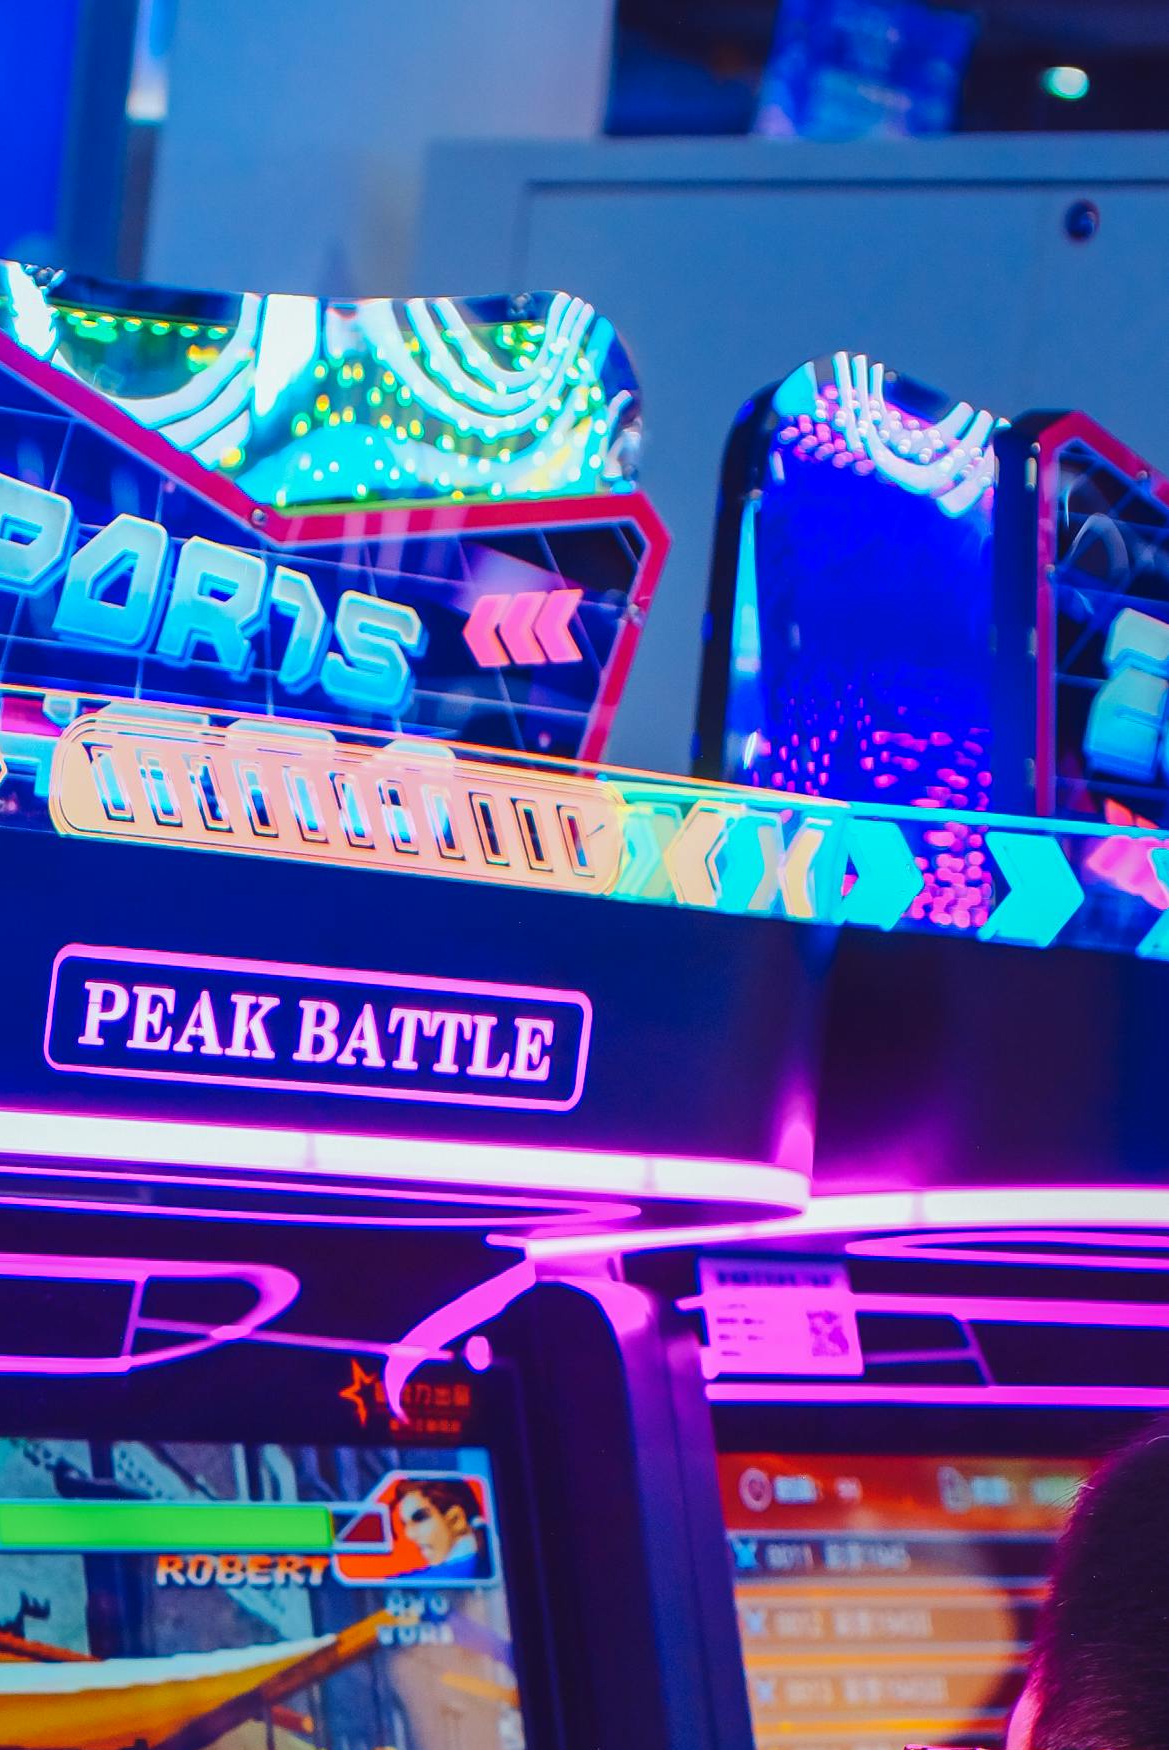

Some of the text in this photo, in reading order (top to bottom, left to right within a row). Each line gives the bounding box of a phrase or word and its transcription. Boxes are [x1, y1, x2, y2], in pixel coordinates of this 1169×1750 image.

[77, 980, 555, 1082] PEAK BATTLE
[155, 1553, 331, 1590] ROBERT
